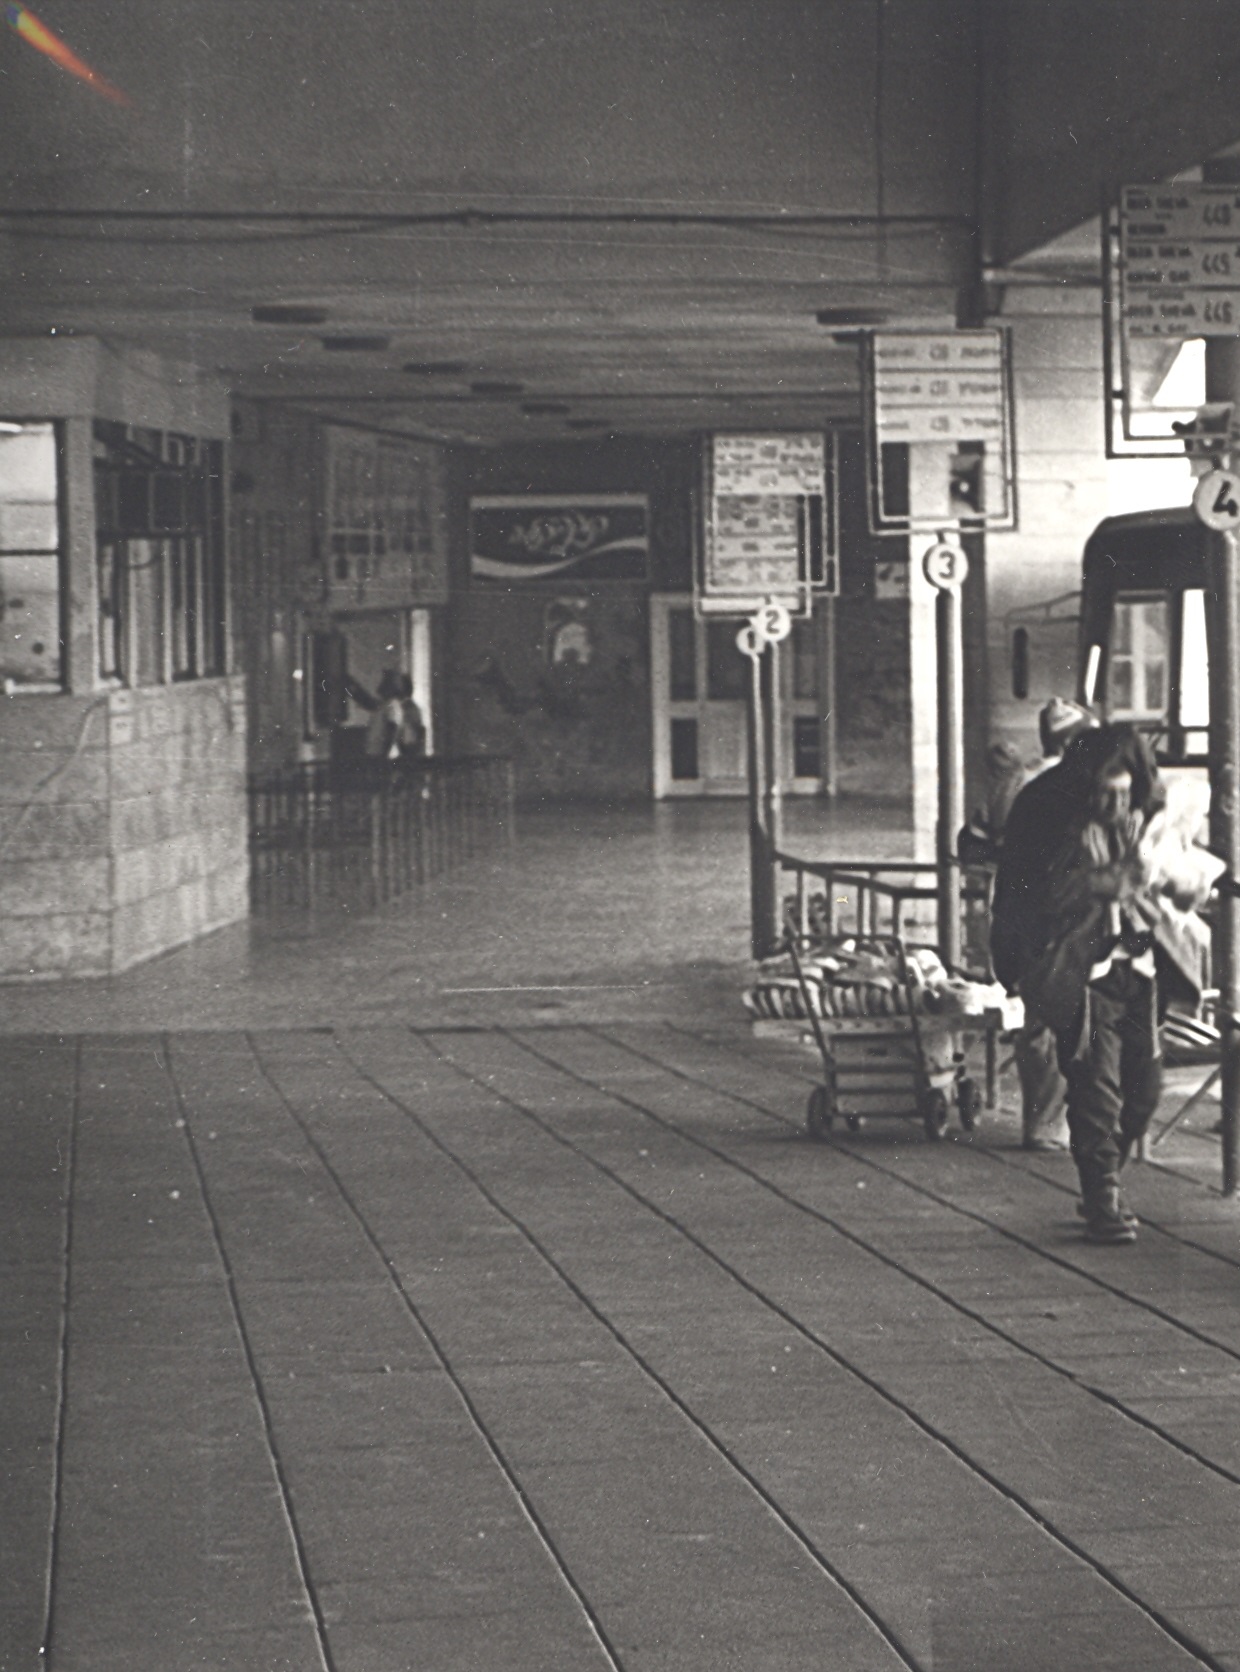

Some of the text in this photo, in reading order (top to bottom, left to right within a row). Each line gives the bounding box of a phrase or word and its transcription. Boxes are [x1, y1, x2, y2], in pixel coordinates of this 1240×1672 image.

[1212, 479, 1240, 518] 4
[938, 550, 956, 580] 3
[765, 609, 780, 634] 2
